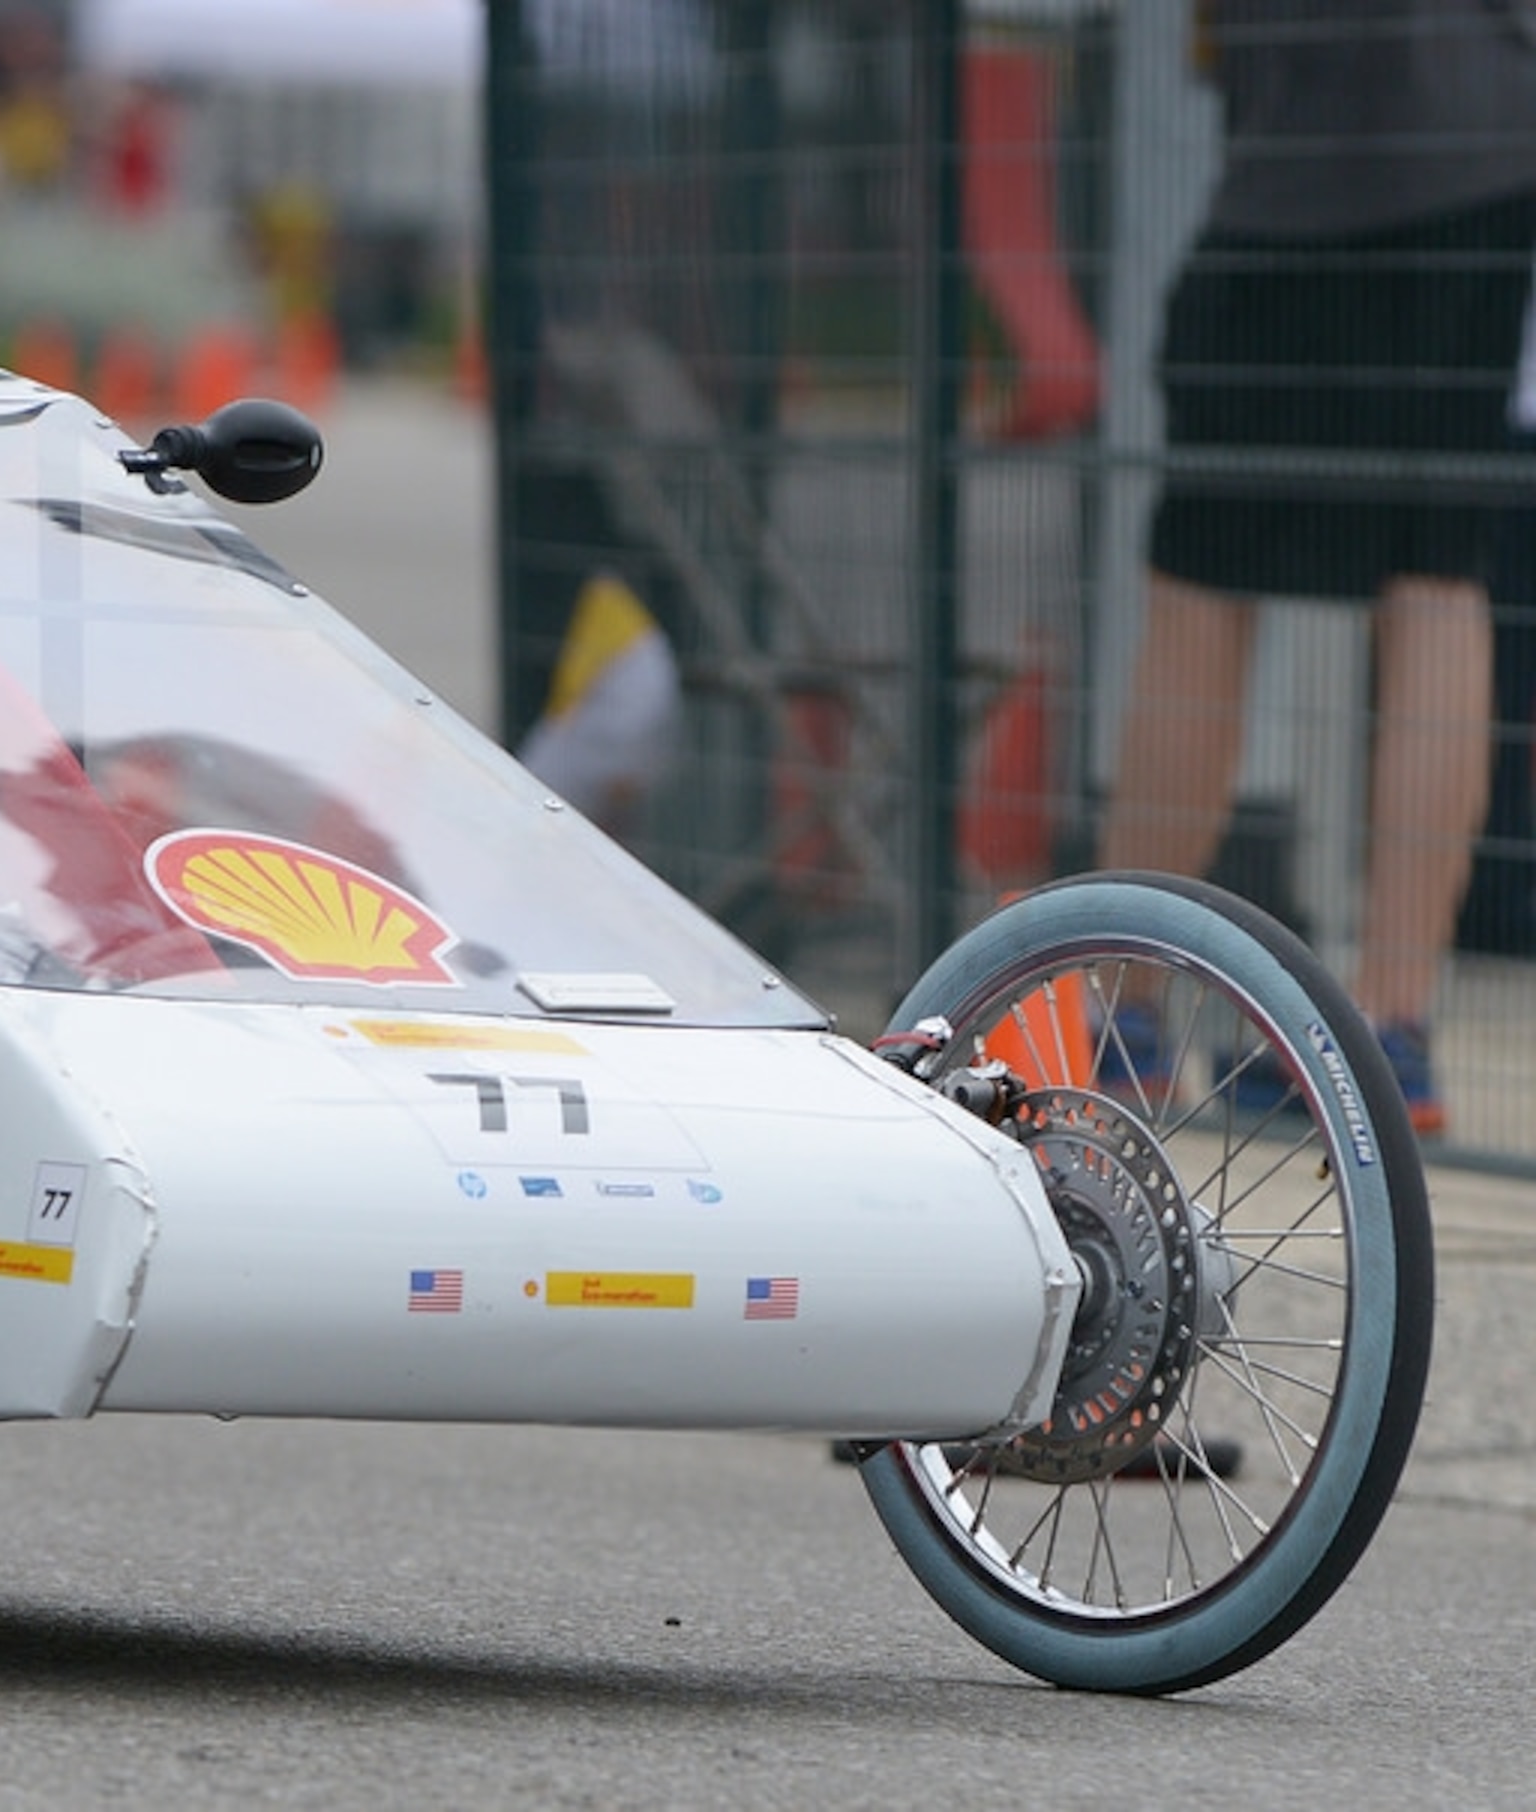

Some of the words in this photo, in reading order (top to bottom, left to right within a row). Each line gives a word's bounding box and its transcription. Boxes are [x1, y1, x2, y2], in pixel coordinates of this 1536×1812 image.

[424, 1073, 590, 1134] 77
[1320, 1050, 1376, 1167] MICHELIN
[39, 1188, 73, 1221] 77
